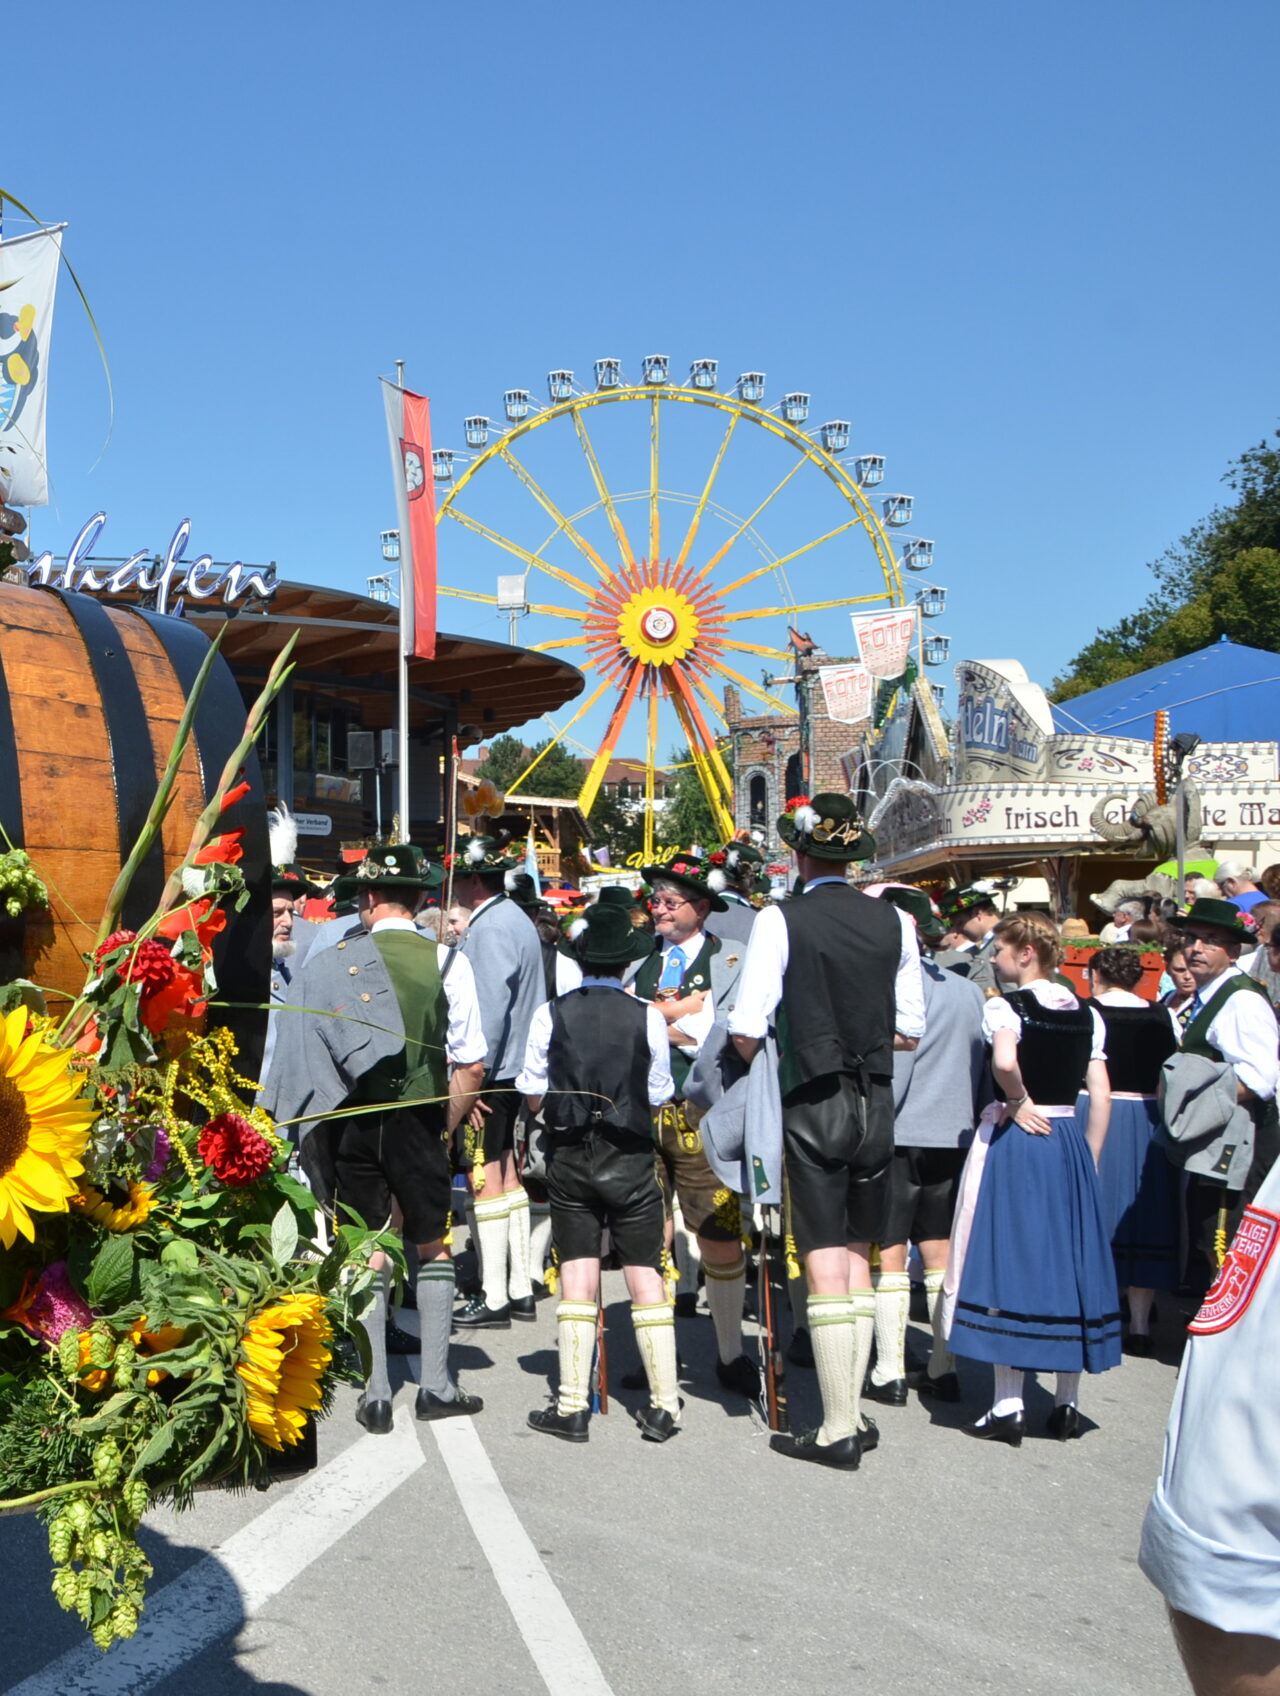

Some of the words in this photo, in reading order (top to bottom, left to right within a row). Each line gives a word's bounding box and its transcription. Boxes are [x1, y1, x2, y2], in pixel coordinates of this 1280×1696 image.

[858, 618, 914, 653] FOTO
[824, 673, 871, 699] FOTO
[1005, 804, 1079, 830] frisch
[1238, 801, 1280, 826] Ma
